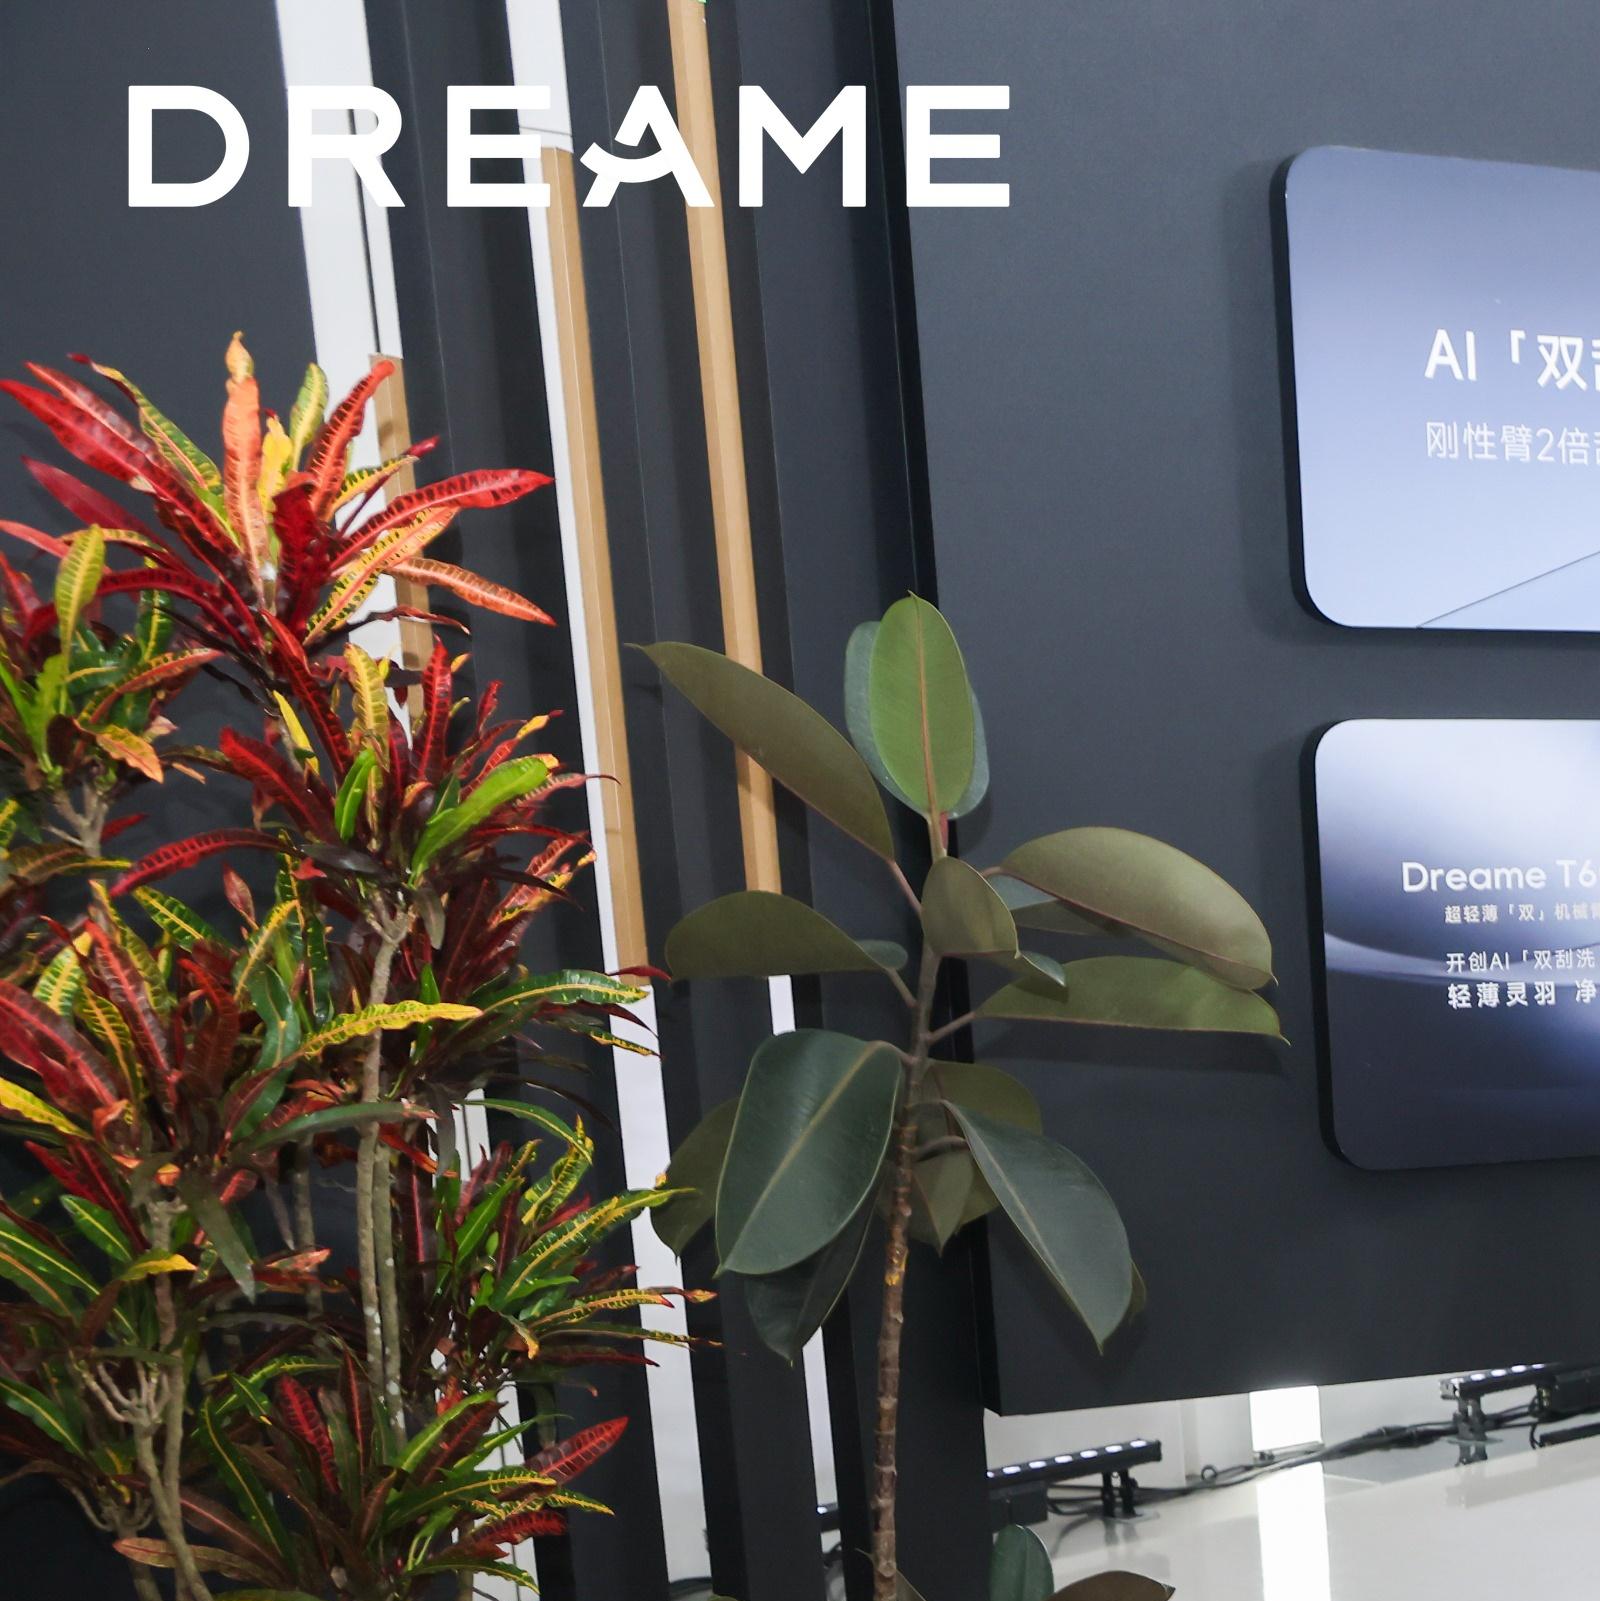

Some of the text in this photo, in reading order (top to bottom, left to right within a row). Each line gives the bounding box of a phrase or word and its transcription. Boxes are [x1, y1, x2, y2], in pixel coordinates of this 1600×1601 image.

[1402, 860, 1547, 893] Dreame
[1447, 981, 1556, 1009] 轻薄灵羽
